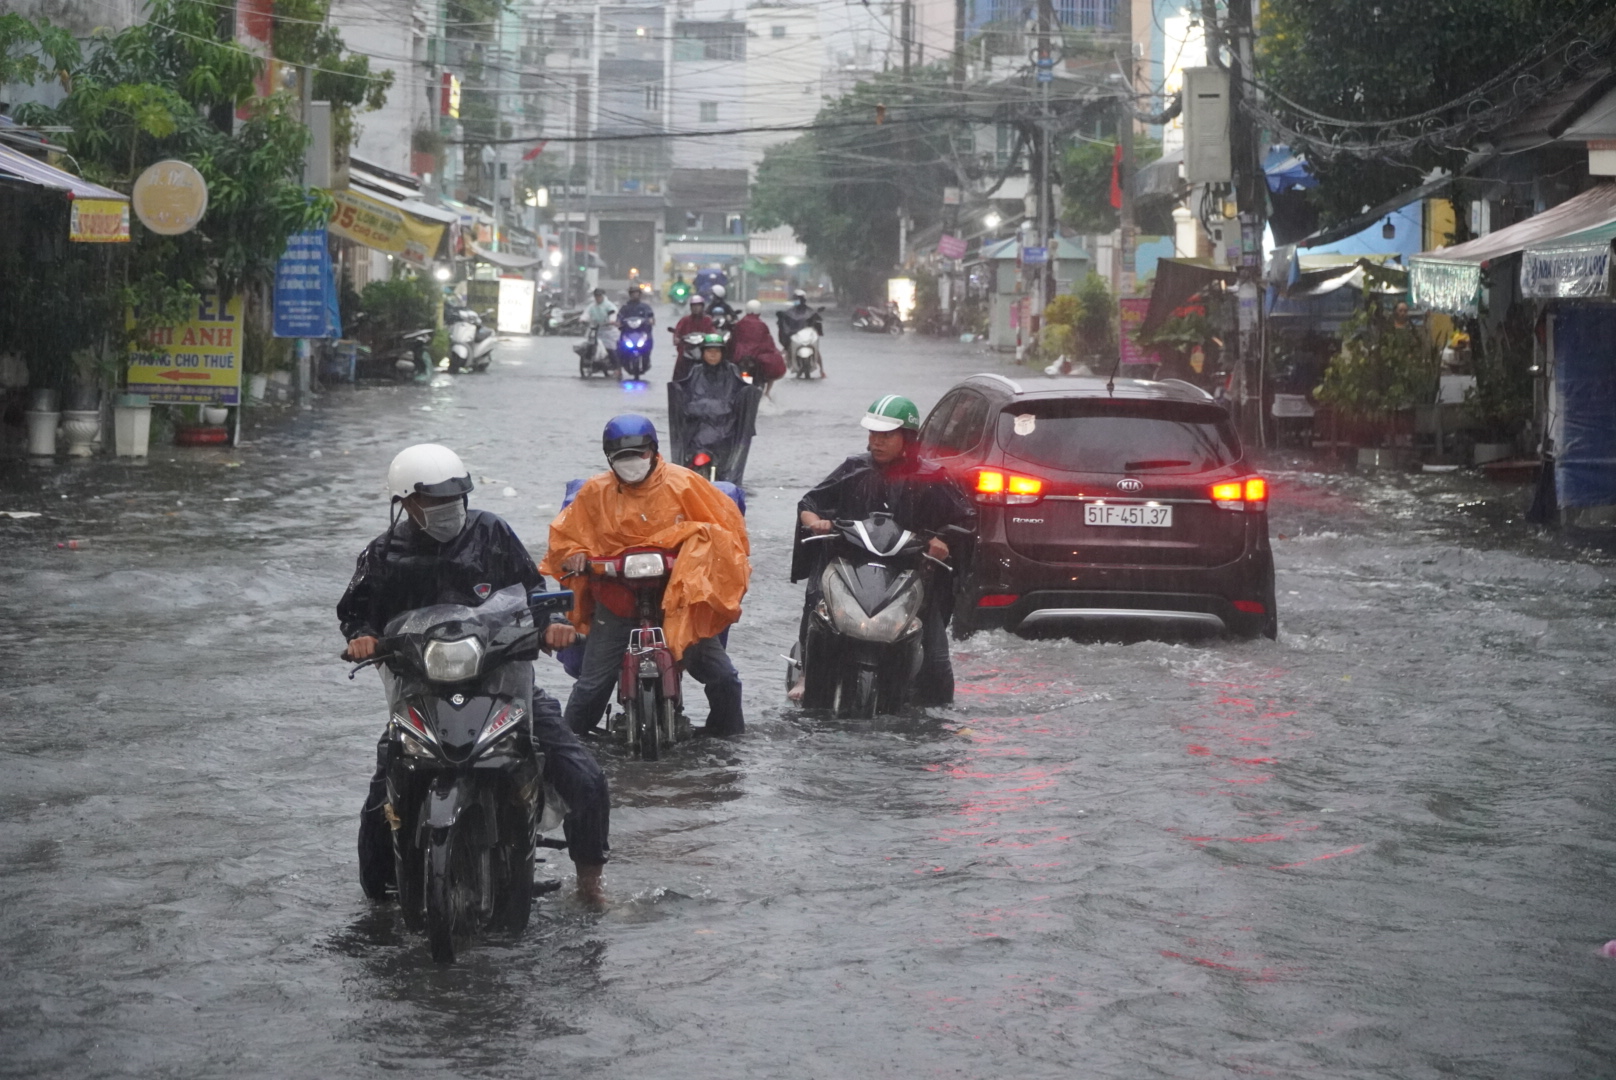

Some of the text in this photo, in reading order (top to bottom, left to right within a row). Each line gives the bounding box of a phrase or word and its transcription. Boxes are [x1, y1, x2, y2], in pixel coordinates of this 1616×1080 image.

[138, 326, 234, 347] HI ANH
[175, 353, 200, 368] CHO
[204, 352, 235, 369] THUÊ
[908, 413, 920, 426] Gra
[1121, 481, 1140, 490] KIA
[1088, 506, 1168, 526] 51F-451.37
